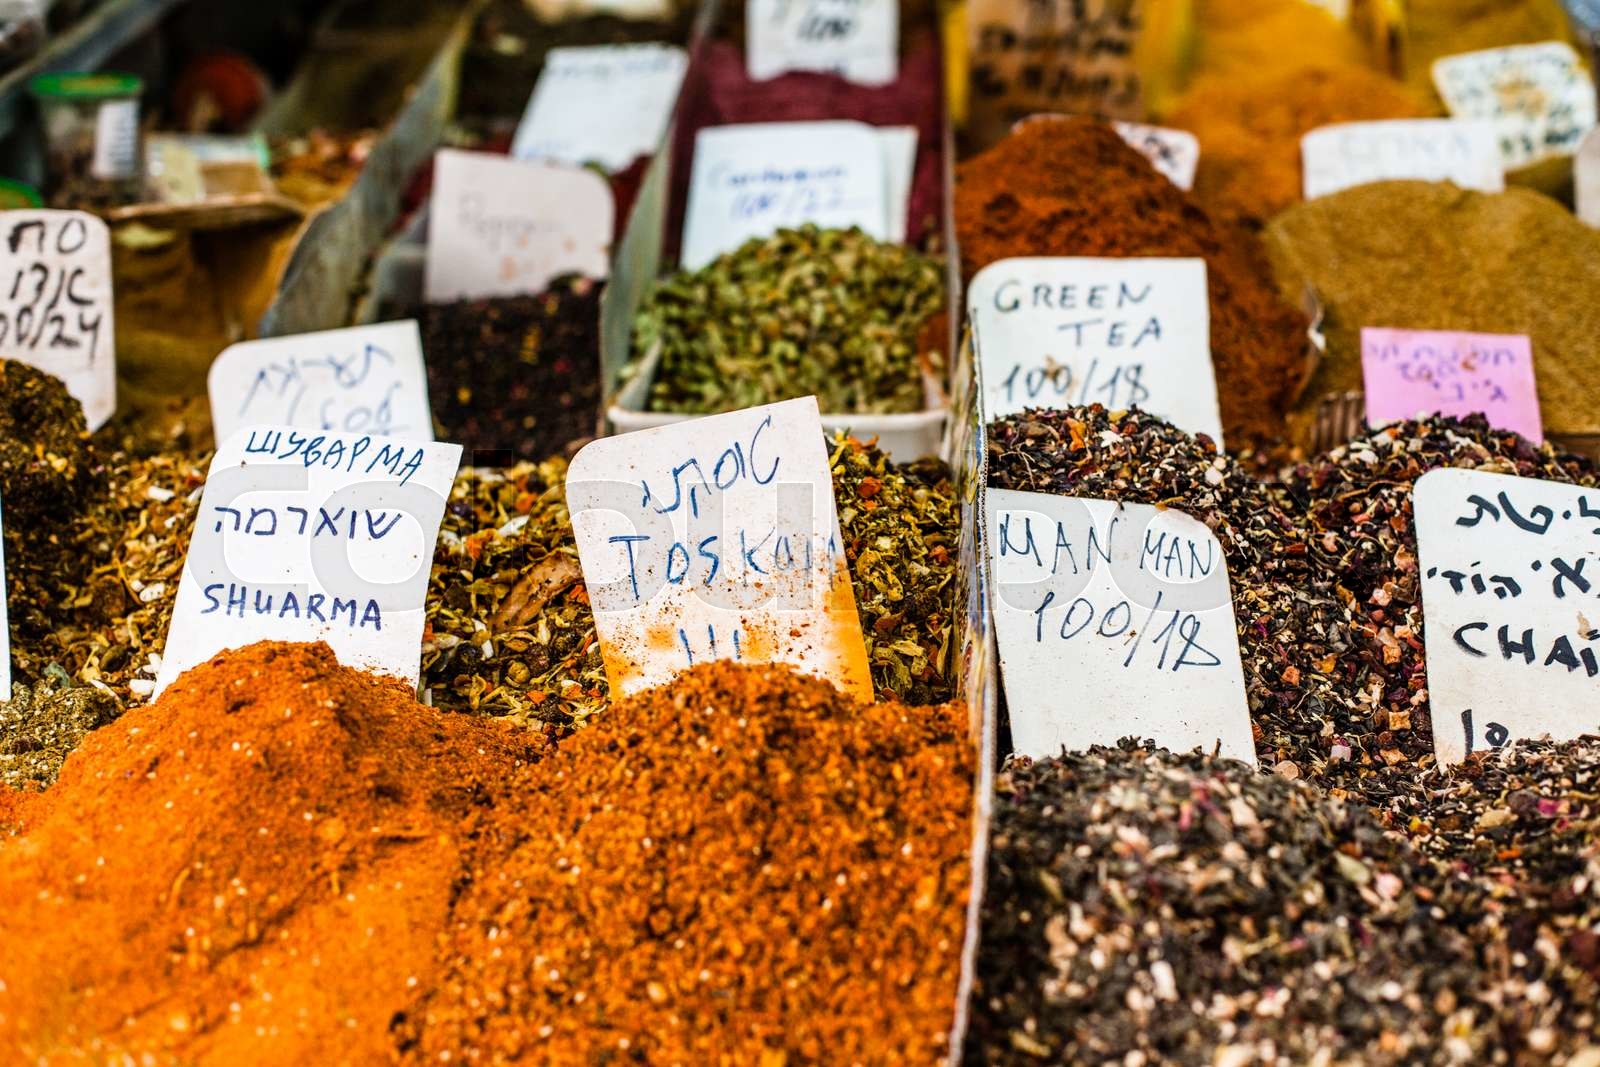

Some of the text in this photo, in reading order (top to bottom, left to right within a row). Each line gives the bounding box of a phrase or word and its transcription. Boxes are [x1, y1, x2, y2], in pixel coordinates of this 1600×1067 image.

[994, 278, 1153, 313] GREEN
[1057, 316, 1162, 348] TEA
[1001, 357, 1150, 407] 100/18
[213, 506, 403, 539] שוארמה
[999, 513, 1213, 579] MAN MAN
[1531, 551, 1600, 599] אי
[200, 583, 382, 632] SHUARMA
[1034, 590, 1222, 672] 100/18
